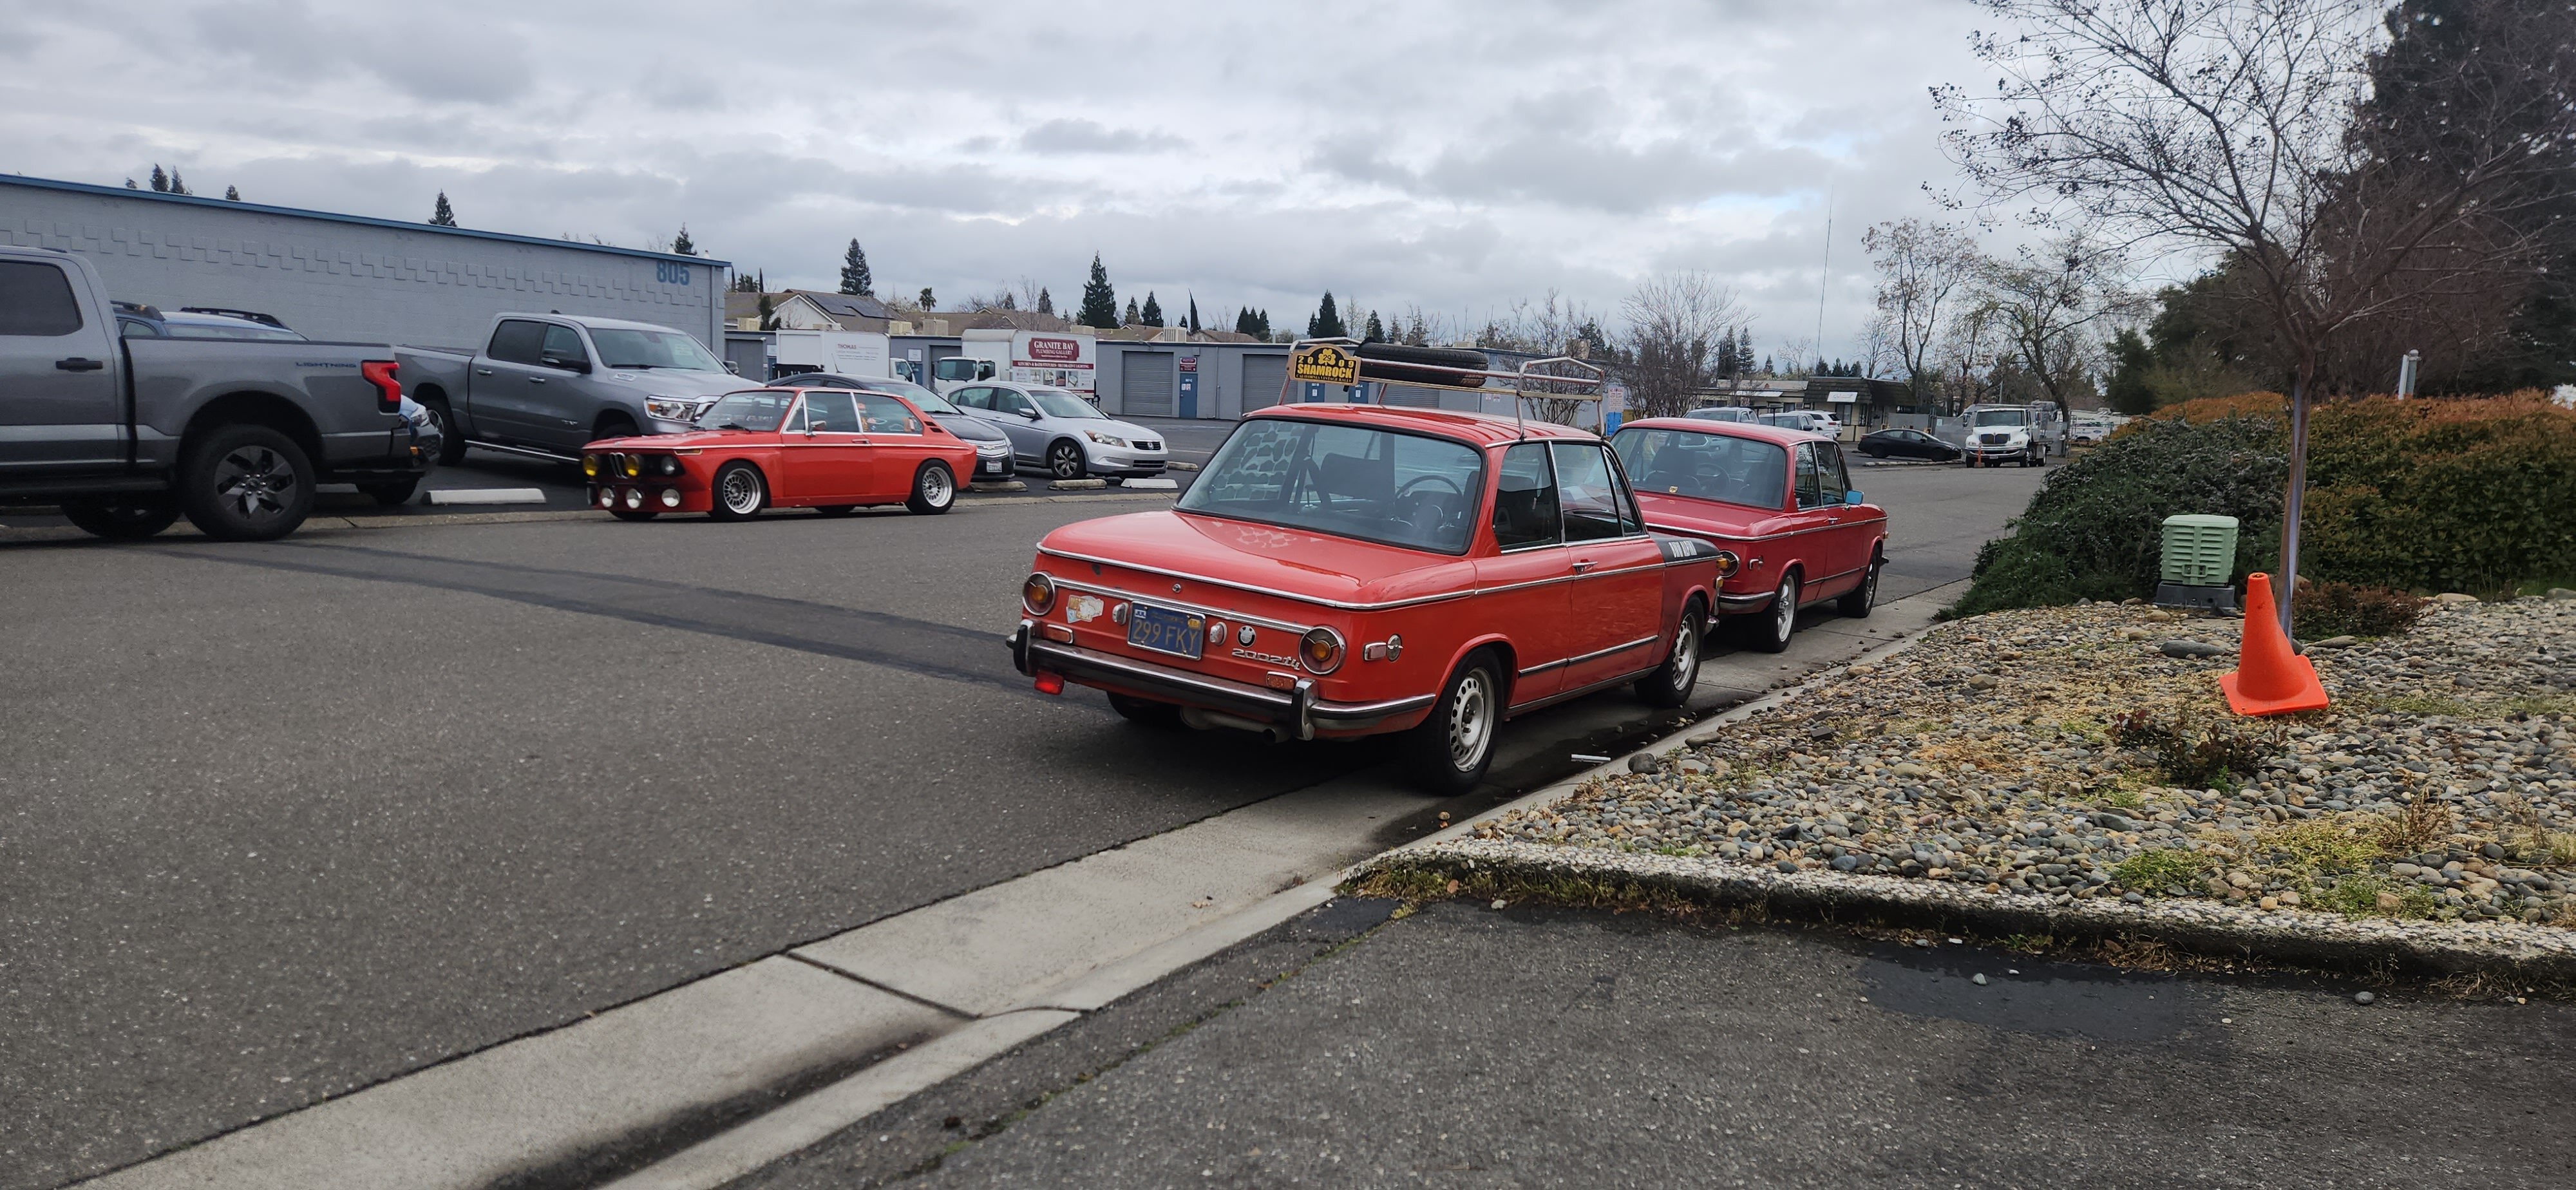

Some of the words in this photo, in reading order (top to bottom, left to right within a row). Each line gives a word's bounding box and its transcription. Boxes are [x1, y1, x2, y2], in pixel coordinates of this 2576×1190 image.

[656, 261, 690, 285] 805
[1034, 341, 1061, 349] GRANITE
[1297, 363, 1353, 378] SHAMROCK
[1133, 619, 1161, 643] 299
[1165, 625, 1198, 653] FKY
